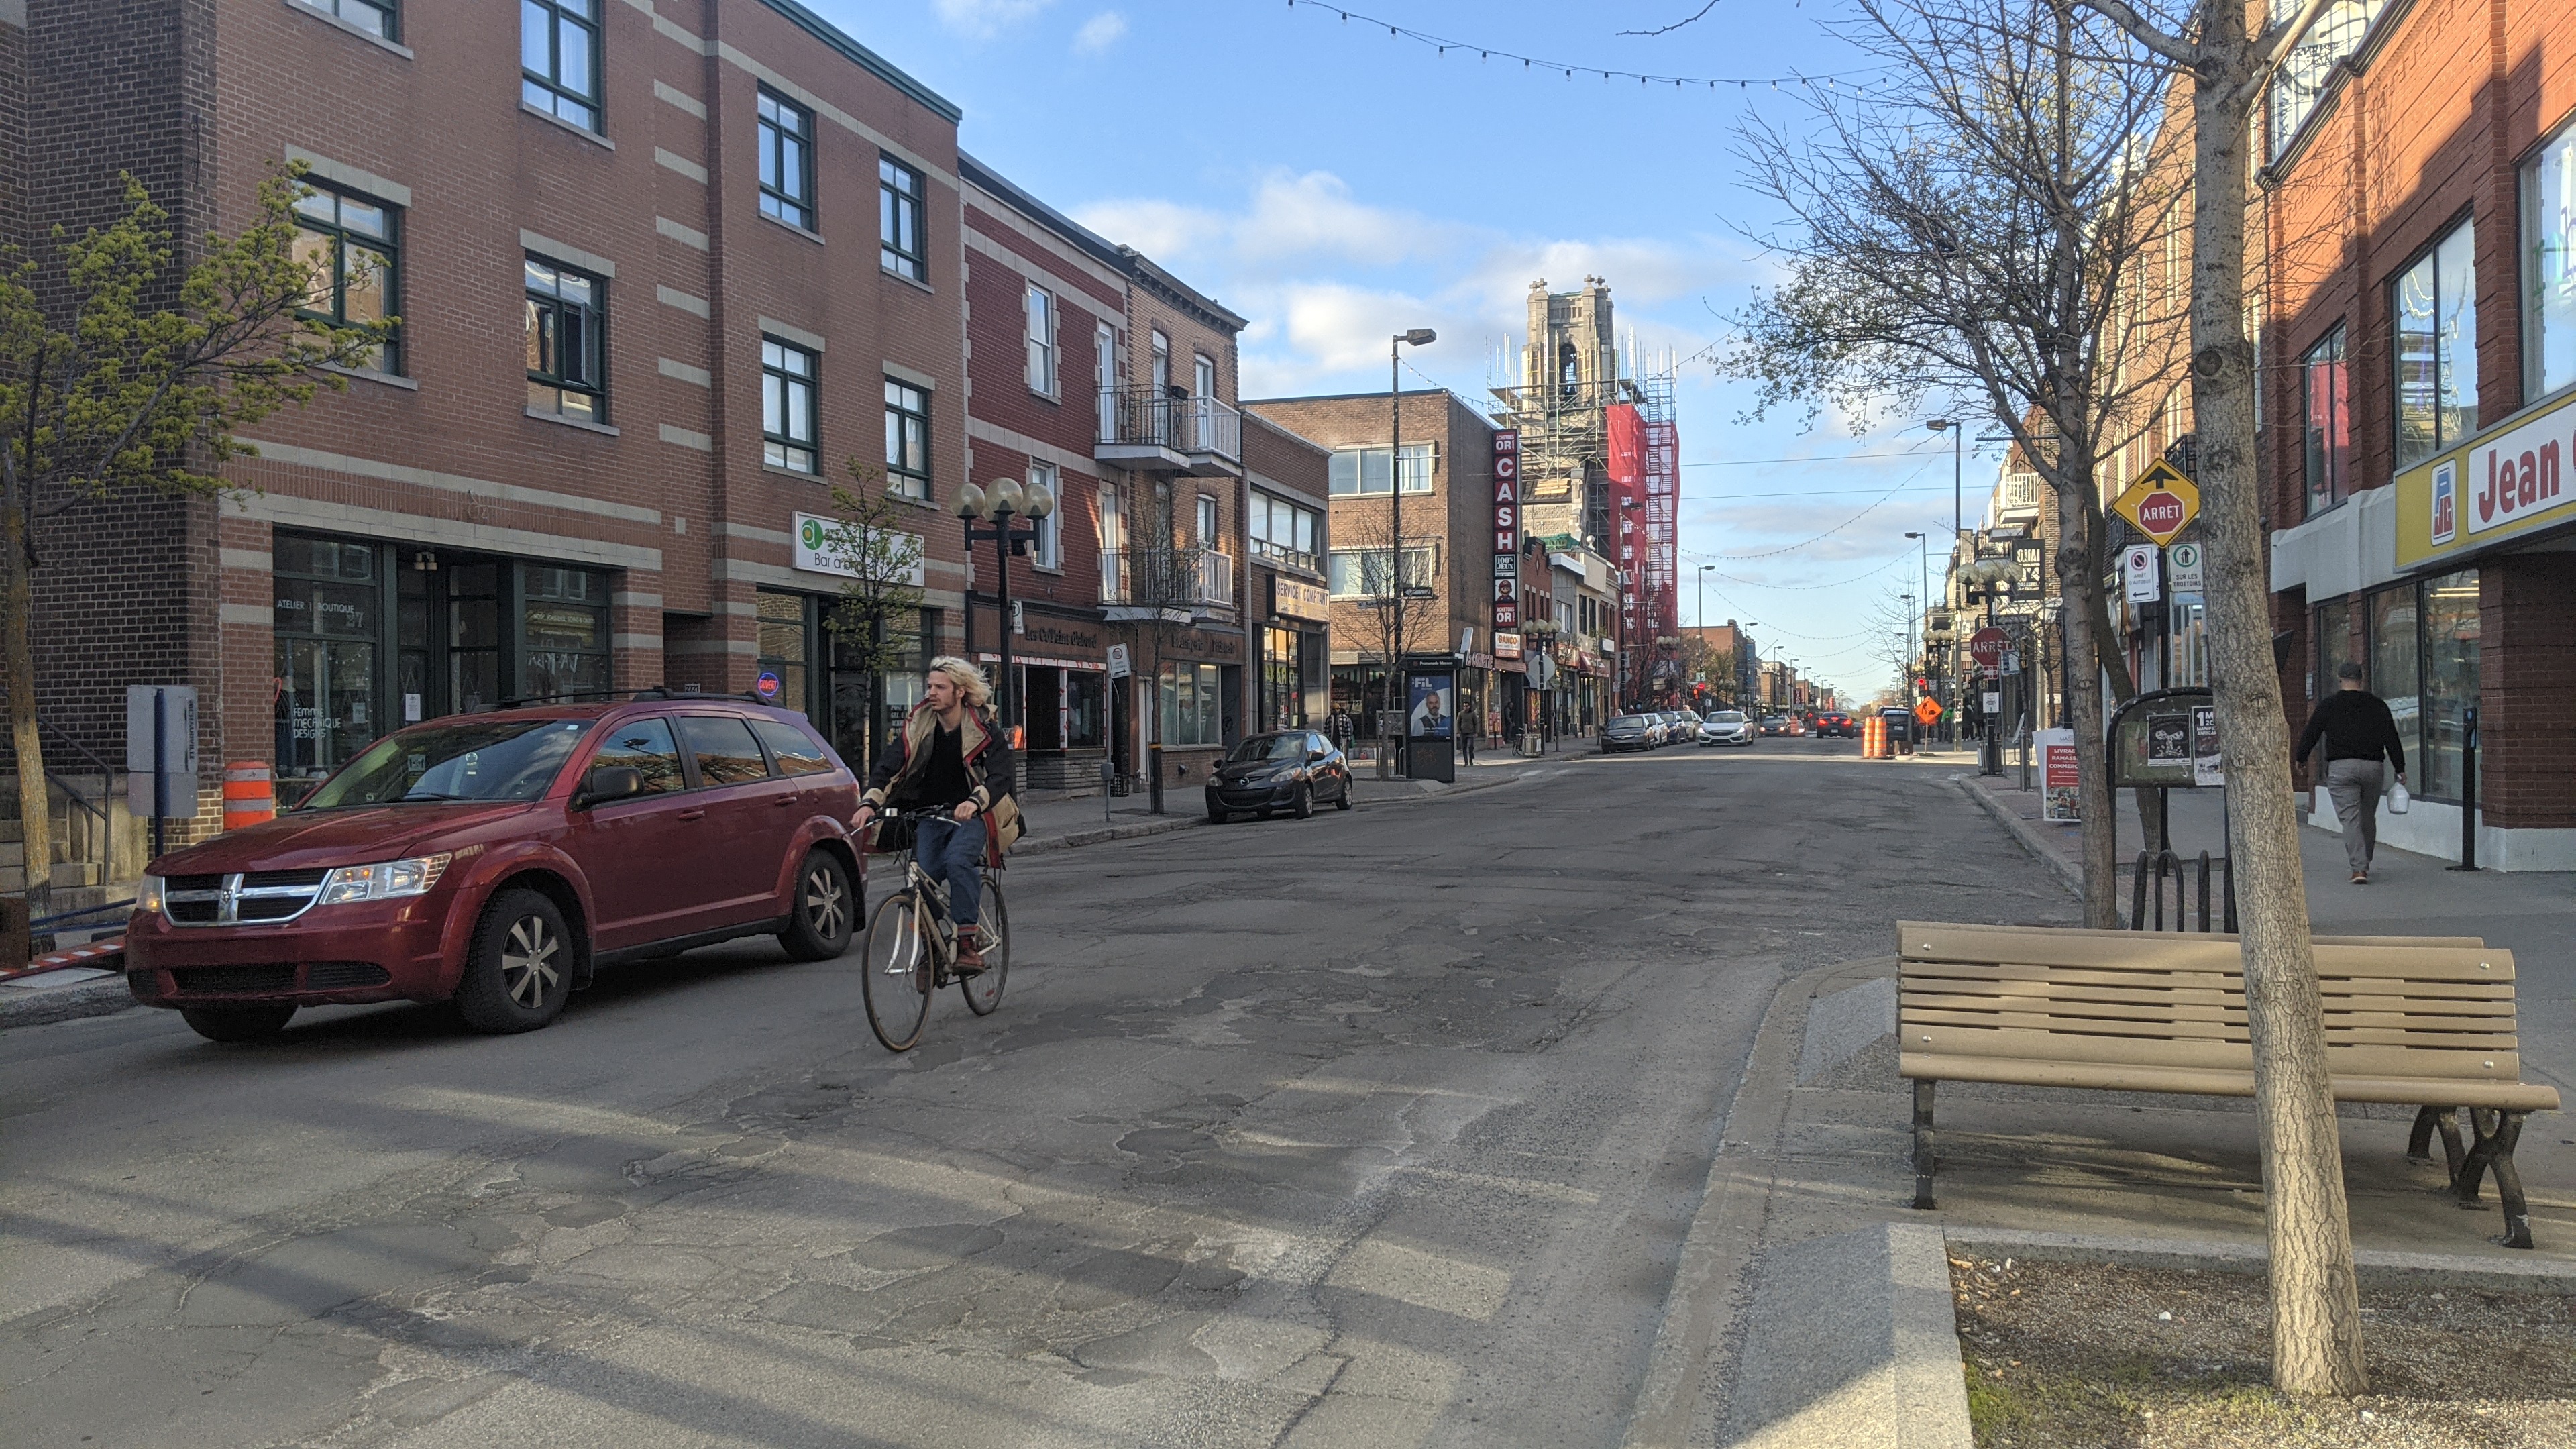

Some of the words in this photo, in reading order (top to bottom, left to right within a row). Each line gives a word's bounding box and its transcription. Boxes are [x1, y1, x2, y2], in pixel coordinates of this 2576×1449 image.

[2478, 439, 2560, 523] Jean
[1497, 458, 1513, 552] CASH
[2143, 504, 2180, 521] ARRÊT
[814, 552, 831, 567] Bar
[834, 555, 841, 569] à
[1277, 581, 1299, 600] SERVICE
[1303, 588, 1328, 606] COMPTANT
[277, 600, 304, 610] ATELIER
[318, 603, 355, 613] BOUTIQUE
[1498, 635, 1517, 645] BANCO
[294, 707, 324, 718] FEMME
[293, 717, 341, 729] MECANIQUE
[293, 728, 326, 739] DESIGNS
